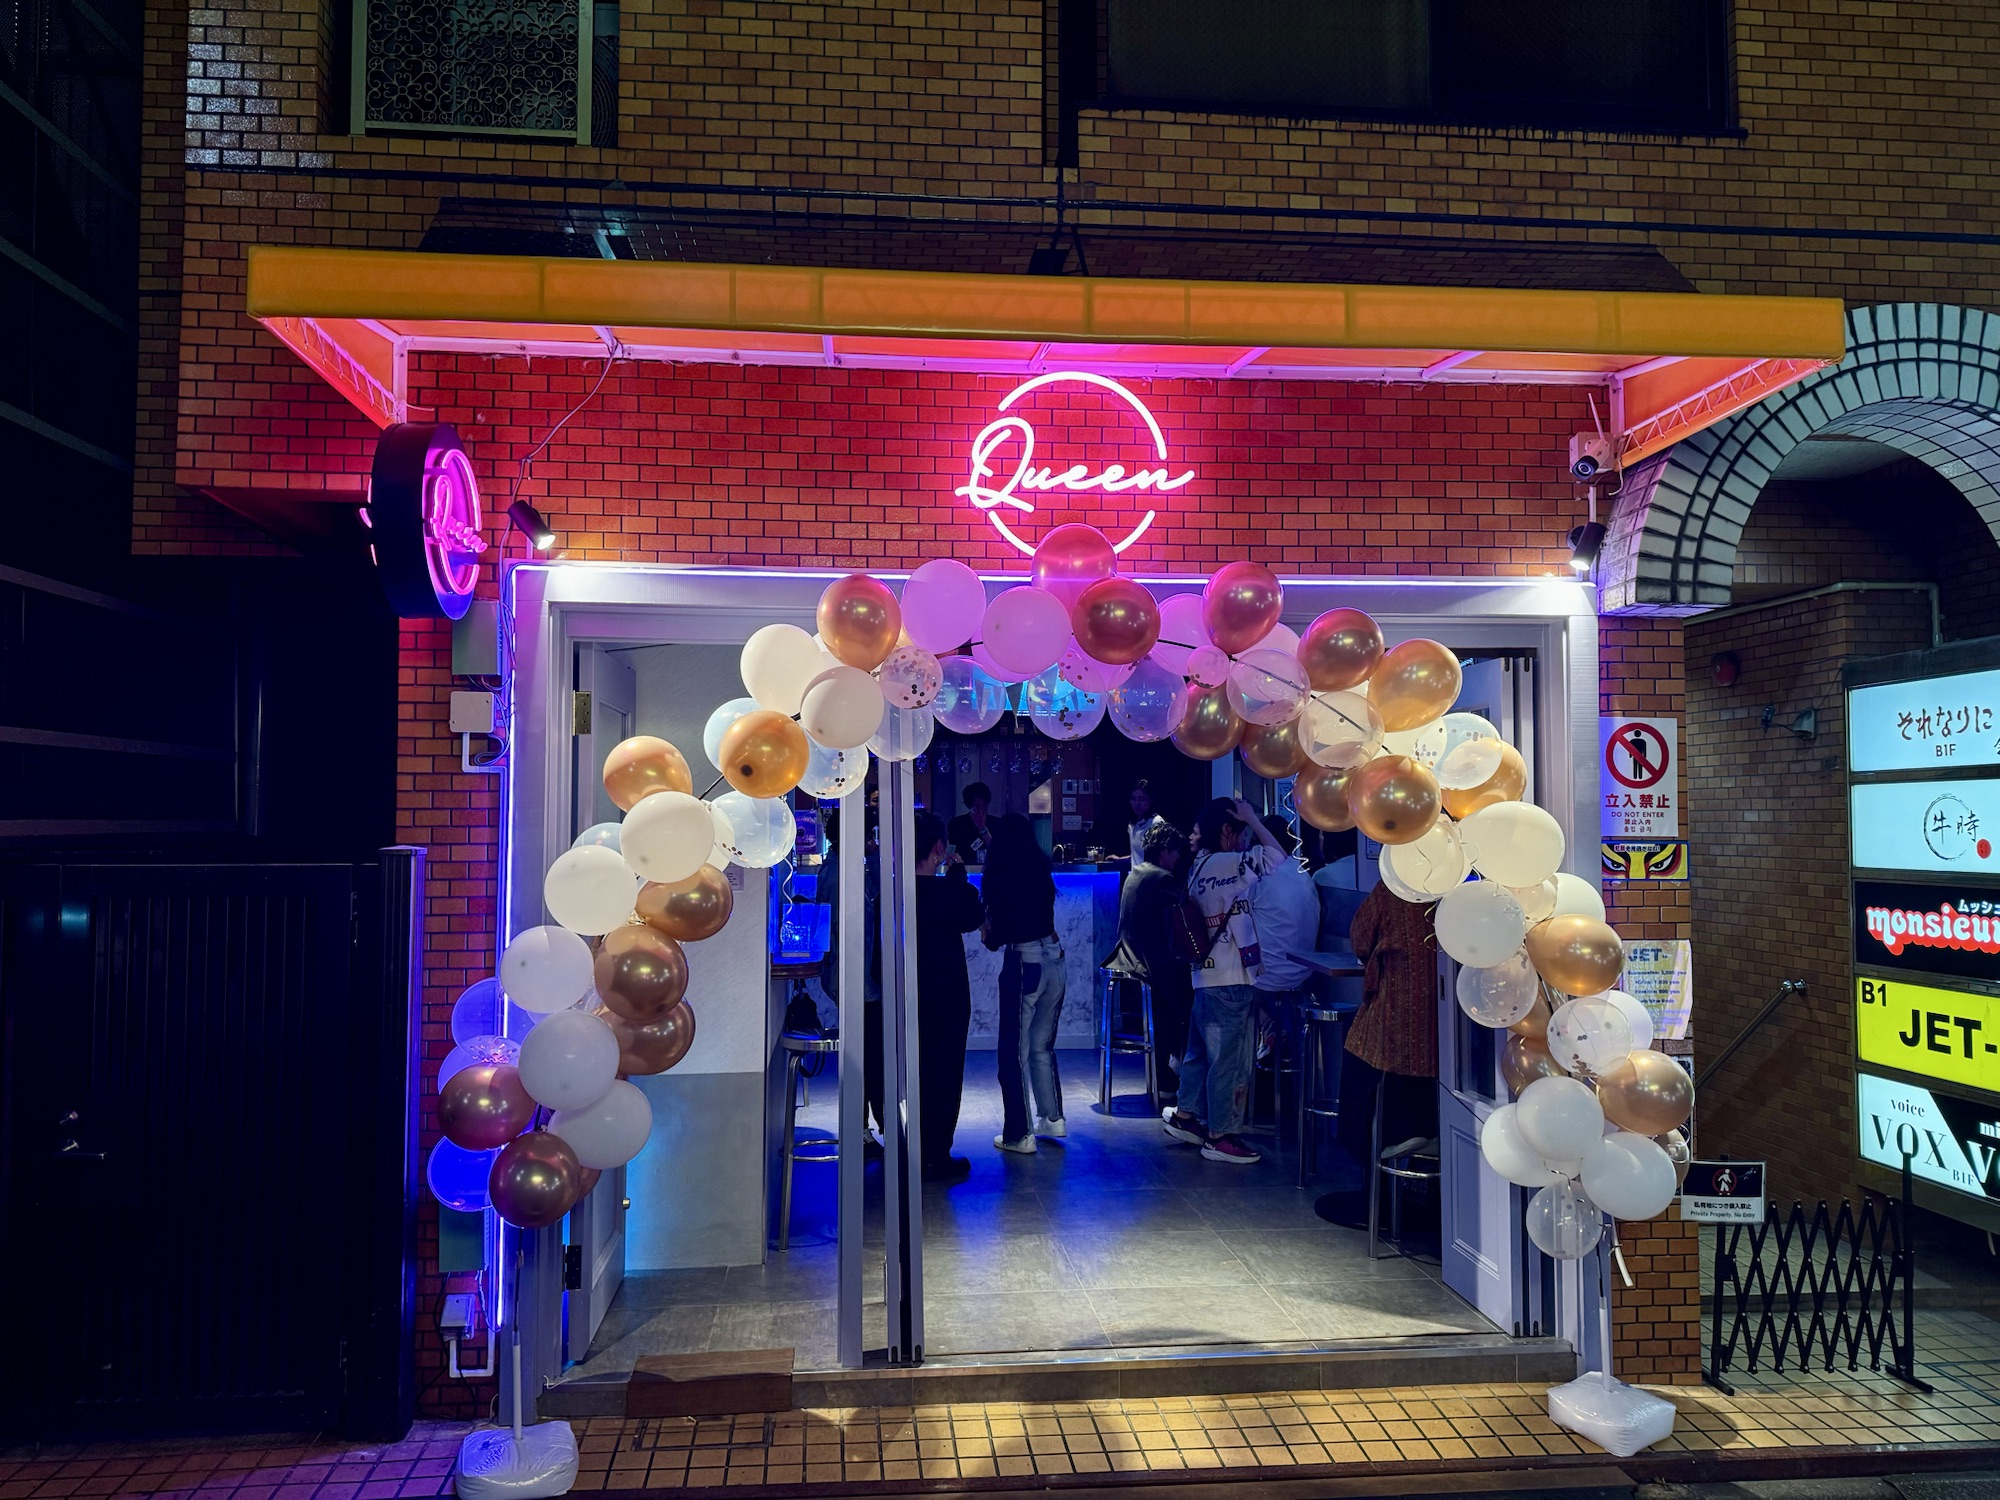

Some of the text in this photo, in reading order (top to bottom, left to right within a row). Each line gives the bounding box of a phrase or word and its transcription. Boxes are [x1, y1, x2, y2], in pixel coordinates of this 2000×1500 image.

[955, 416, 1195, 513] Queen
[1897, 705, 1993, 740] それなりに
[1605, 794, 1670, 809] 立入禁止
[1931, 809, 1980, 845] 牛時
[1861, 980, 1887, 1007] B1
[1899, 1008, 1998, 1060] JET-
[1891, 1099, 1925, 1117] voice
[1870, 1113, 1949, 1171] VOX
[1966, 1140, 2000, 1184] V
